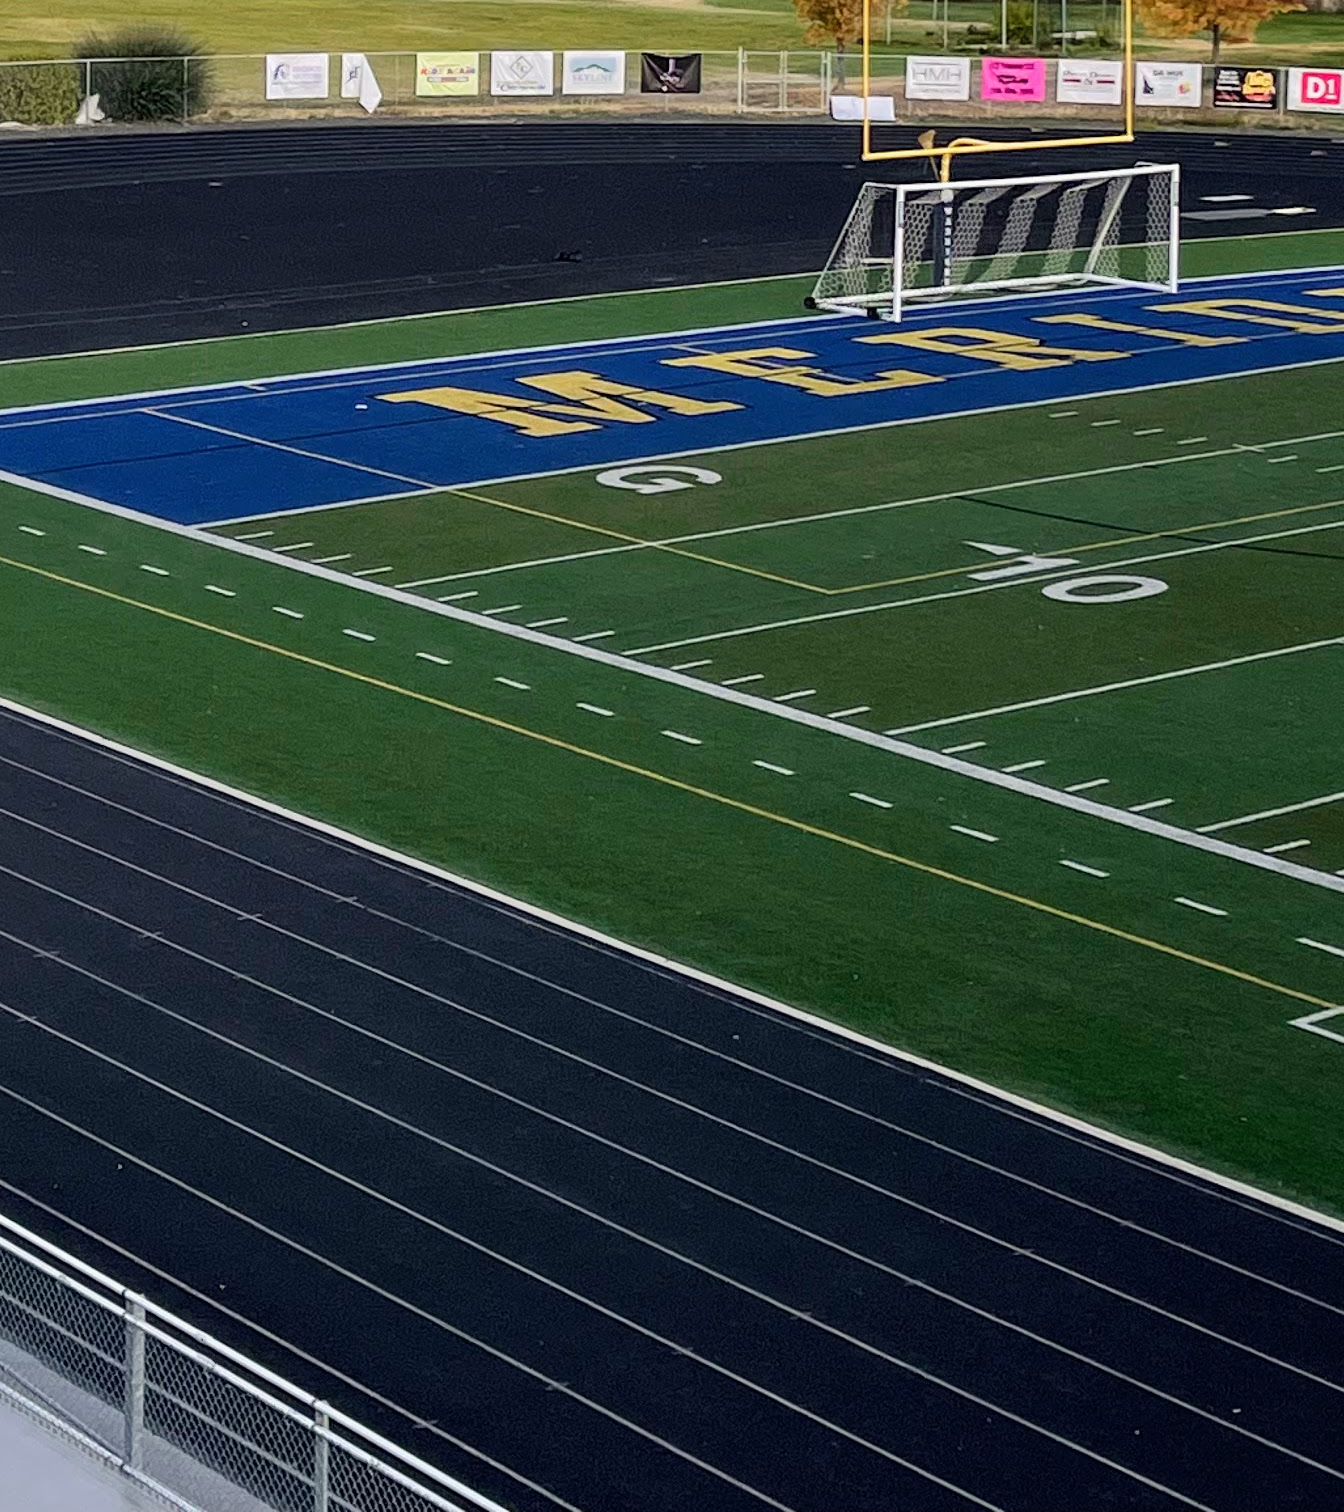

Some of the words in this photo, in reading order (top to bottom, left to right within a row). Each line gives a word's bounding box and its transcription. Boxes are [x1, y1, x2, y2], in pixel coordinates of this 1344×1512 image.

[1306, 76, 1337, 99] D1
[595, 464, 723, 495] G
[967, 553, 1169, 604] 10
